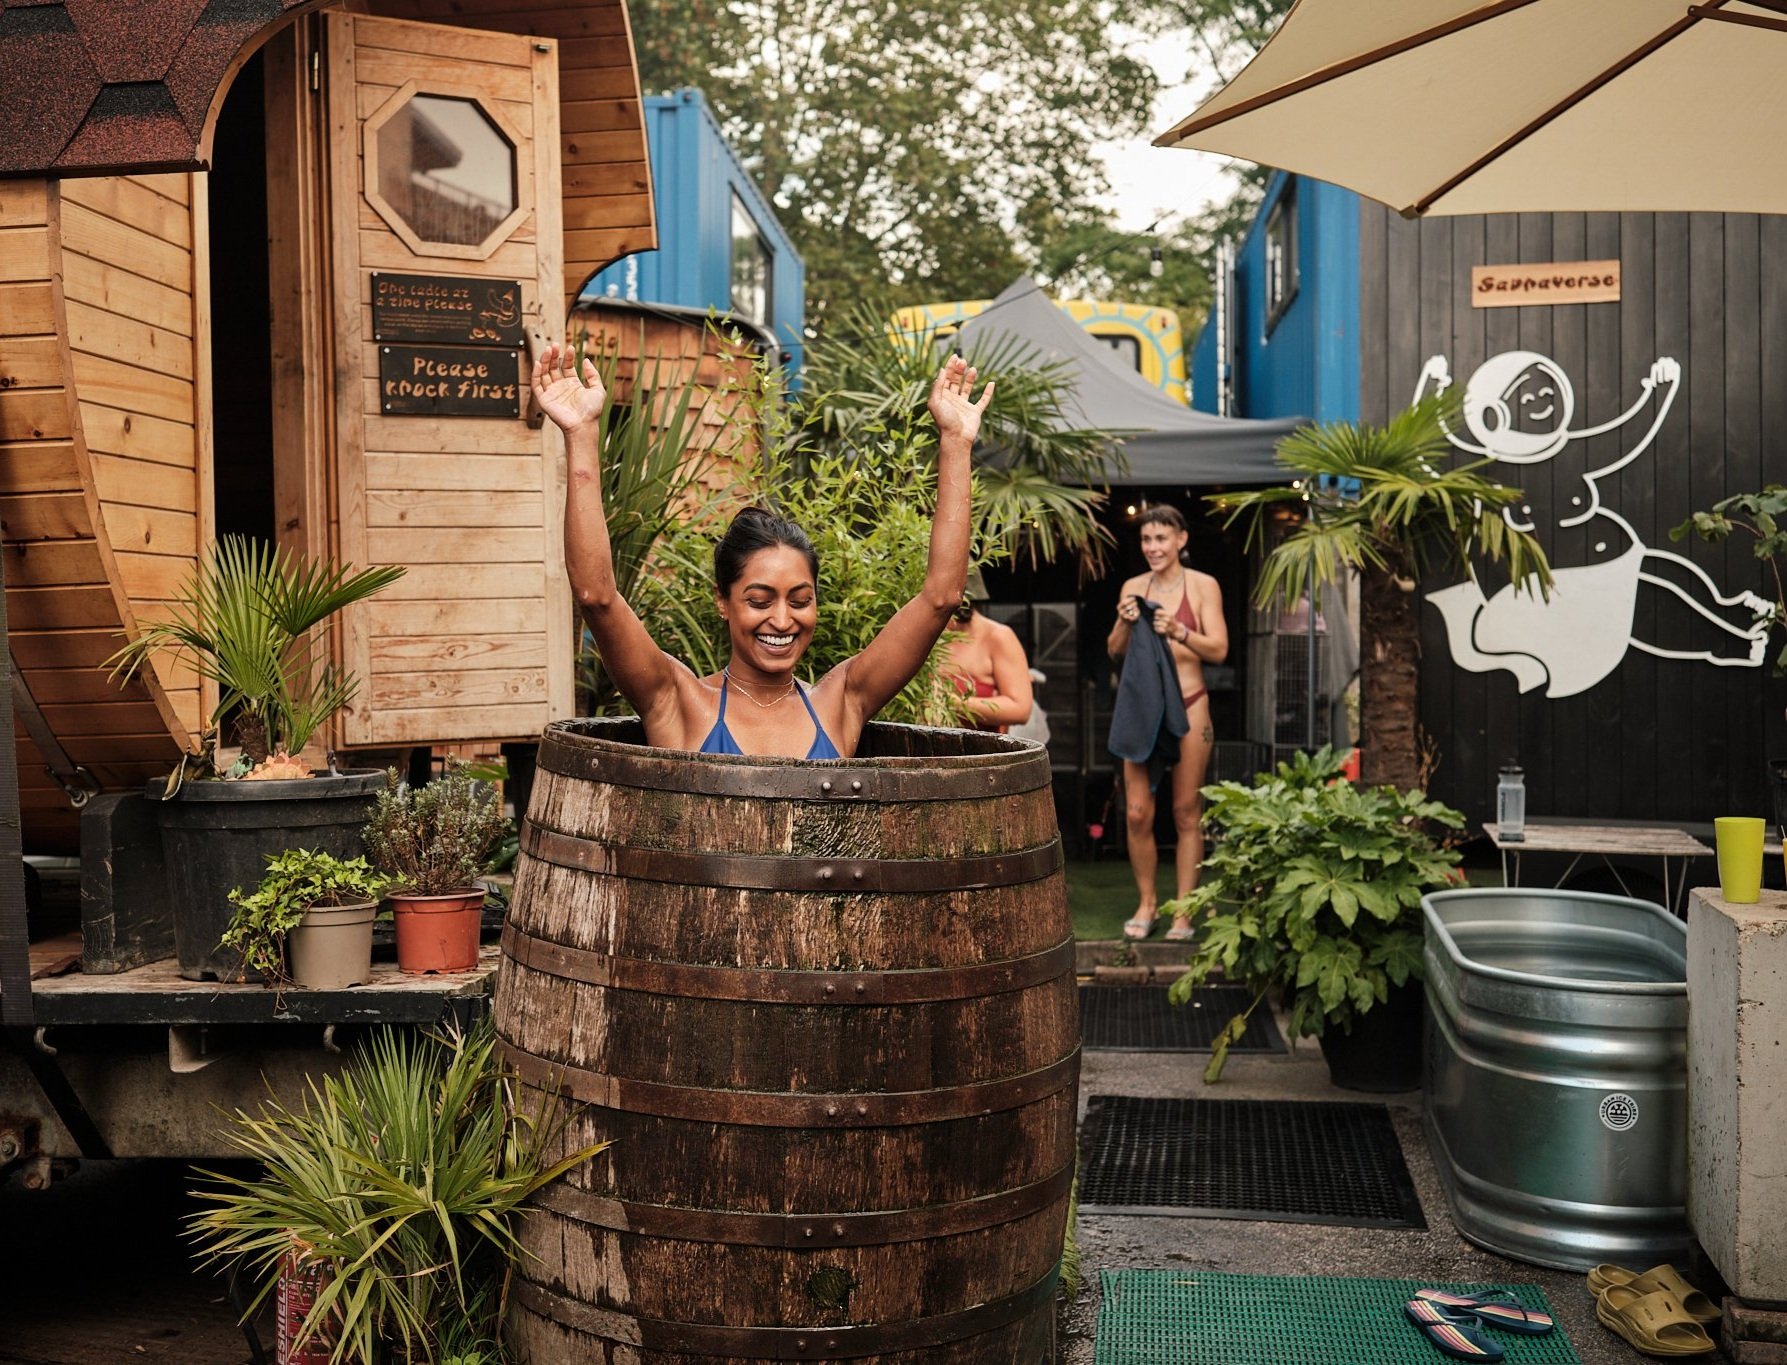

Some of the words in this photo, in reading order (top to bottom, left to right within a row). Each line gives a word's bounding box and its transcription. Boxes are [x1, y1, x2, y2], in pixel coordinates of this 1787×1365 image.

[410, 284, 449, 297] ladle
[453, 288, 470, 298] at
[1478, 274, 1615, 292] Saunaverse
[376, 297, 384, 307] a
[390, 296, 421, 308] time
[425, 299, 473, 311] please
[414, 357, 488, 378] Please
[458, 380, 515, 399] first
